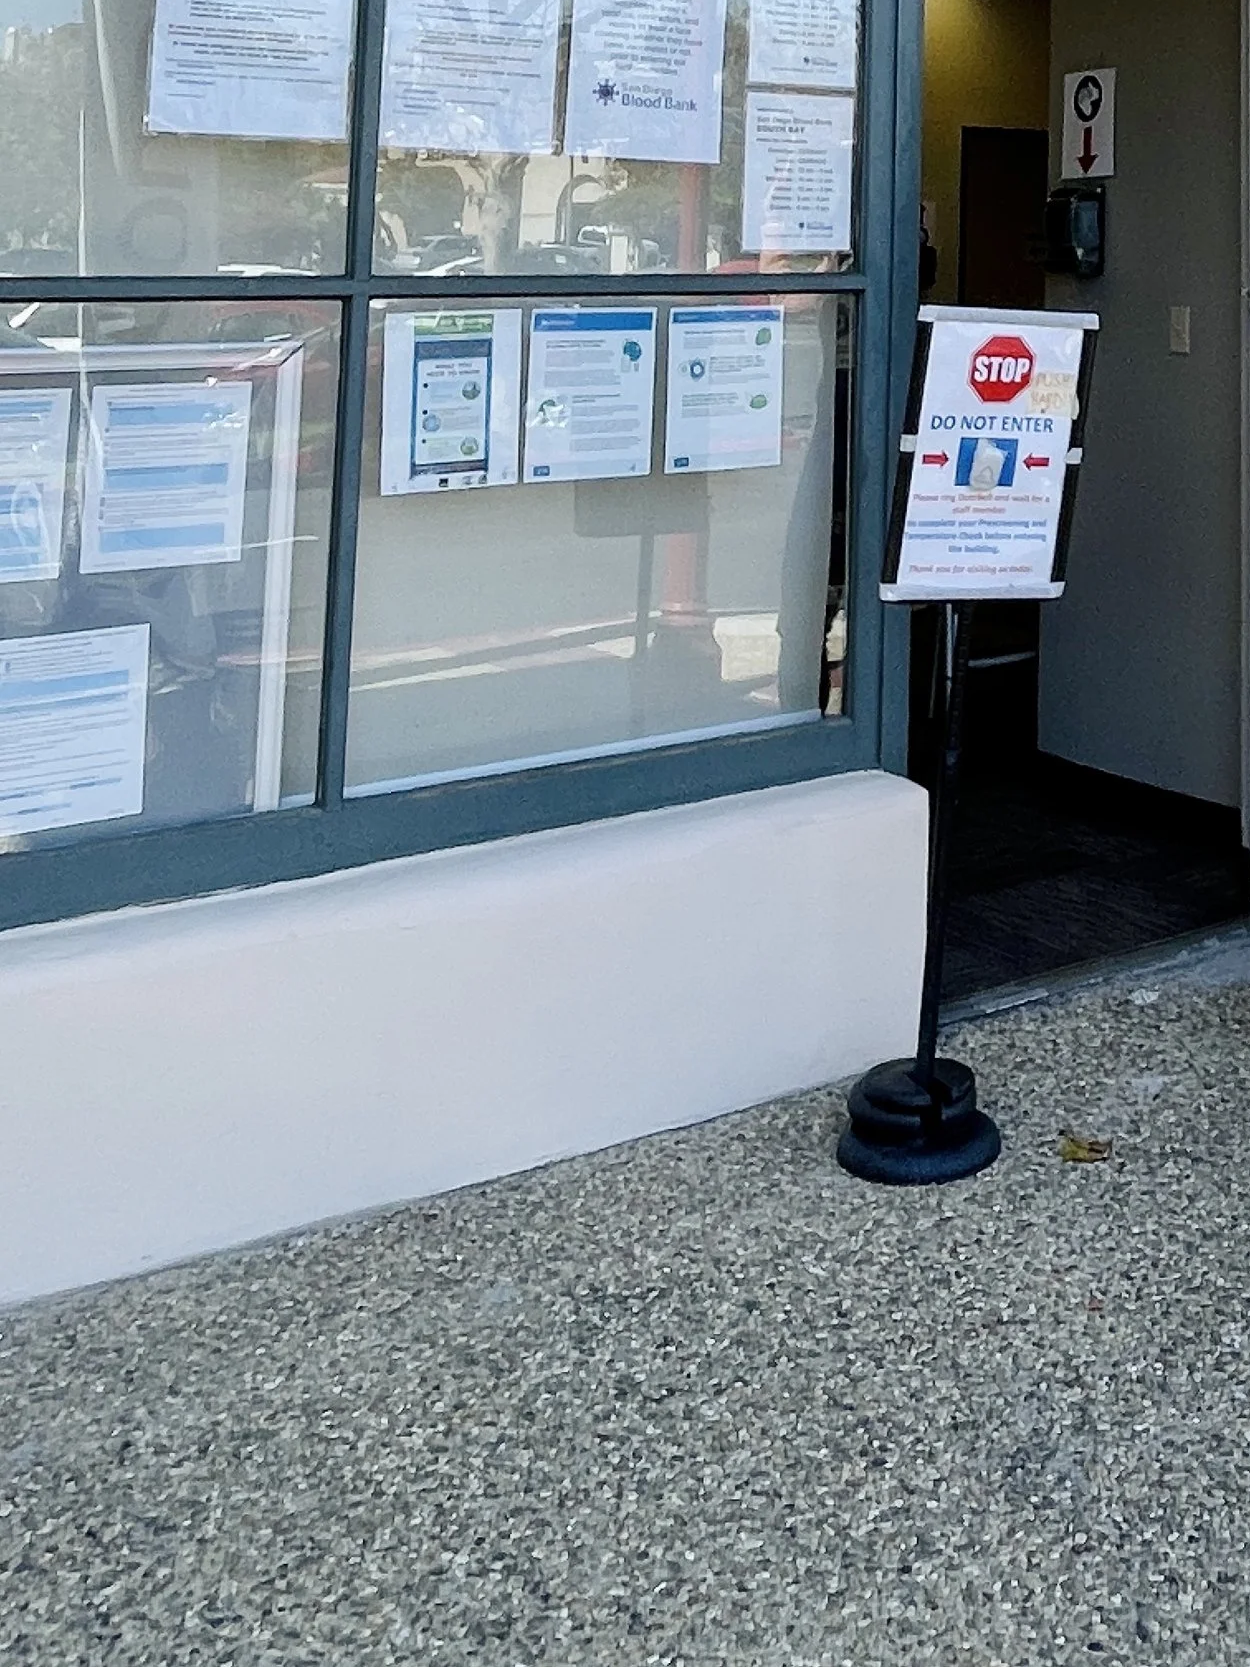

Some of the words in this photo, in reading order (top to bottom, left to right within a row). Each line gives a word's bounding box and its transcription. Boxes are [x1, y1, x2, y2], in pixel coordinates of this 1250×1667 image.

[621, 93, 662, 110] Blood
[664, 96, 698, 112] Bank
[974, 356, 1031, 383] STOP
[931, 415, 956, 431] DO
[960, 416, 998, 431] NOT
[1001, 417, 1054, 433] ENTER
